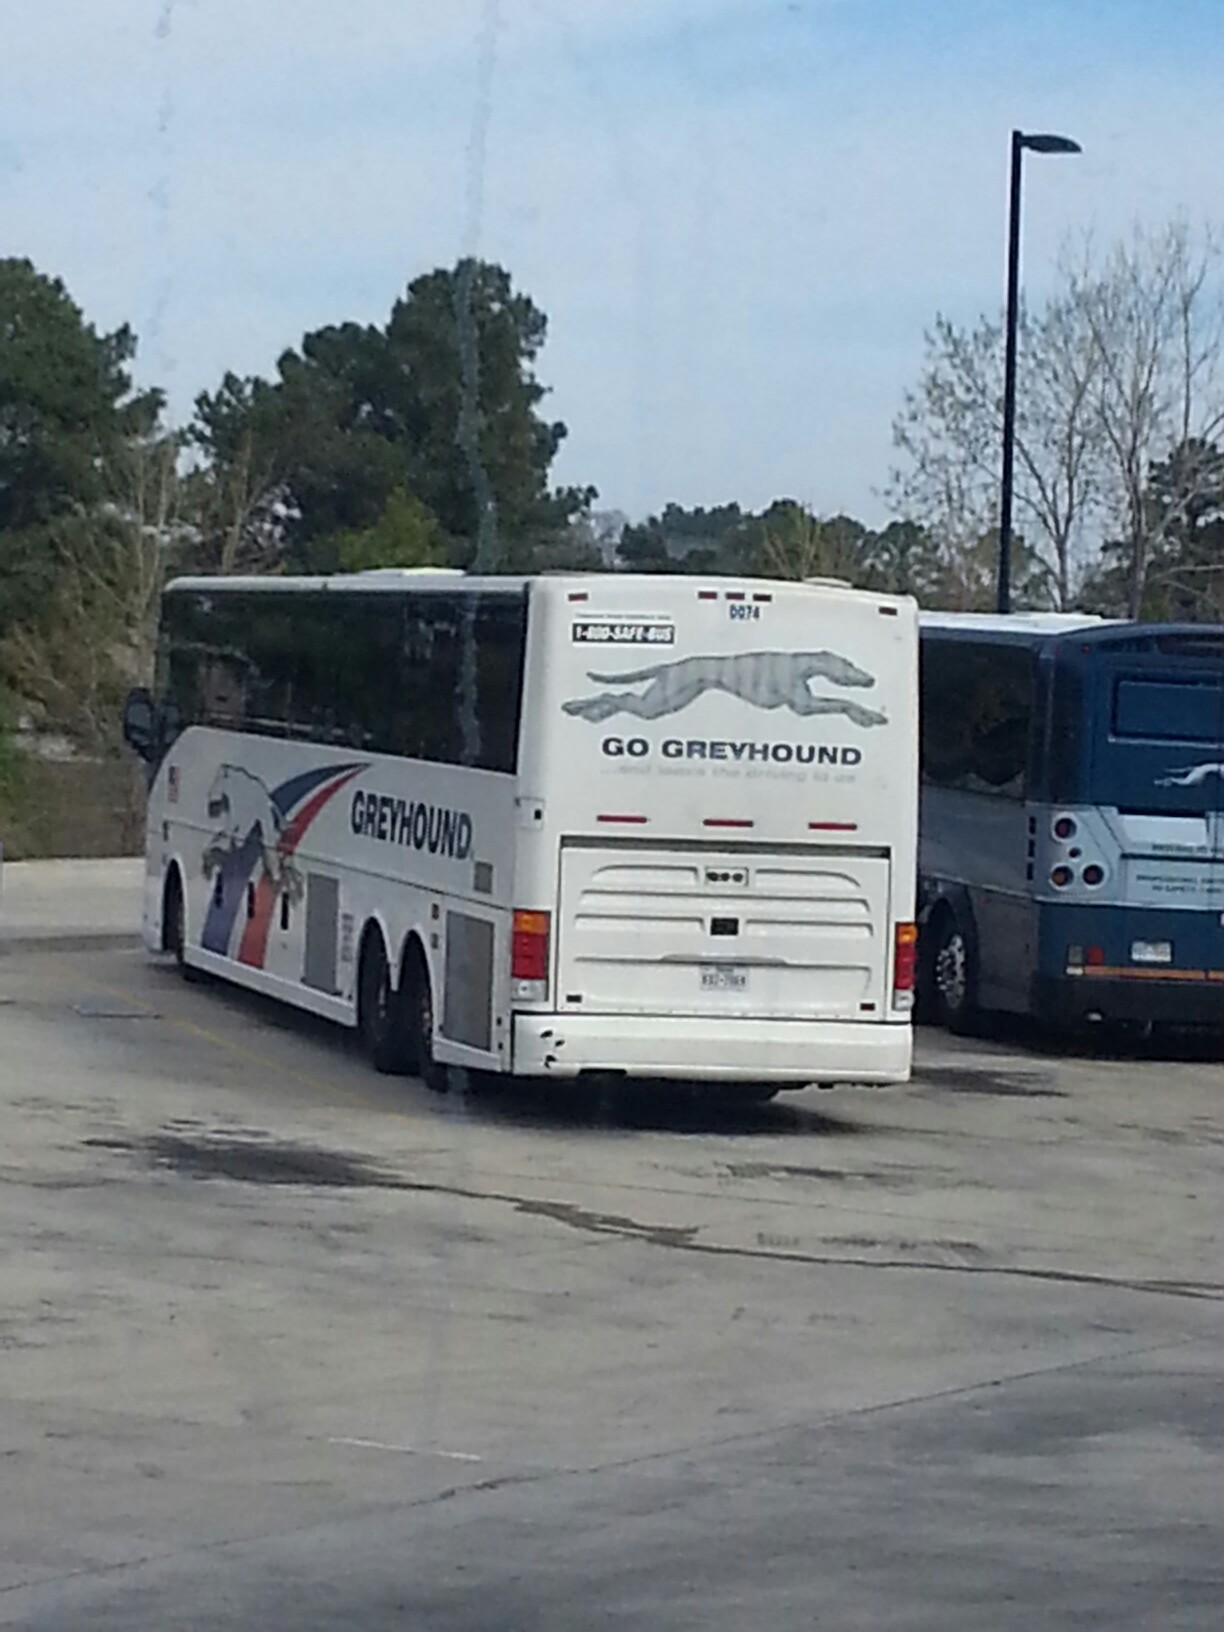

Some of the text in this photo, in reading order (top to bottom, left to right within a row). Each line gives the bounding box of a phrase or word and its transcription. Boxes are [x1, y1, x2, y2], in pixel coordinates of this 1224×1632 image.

[602, 737, 862, 766] GO GREYHOUND
[352, 790, 472, 860] GREYHOUND
